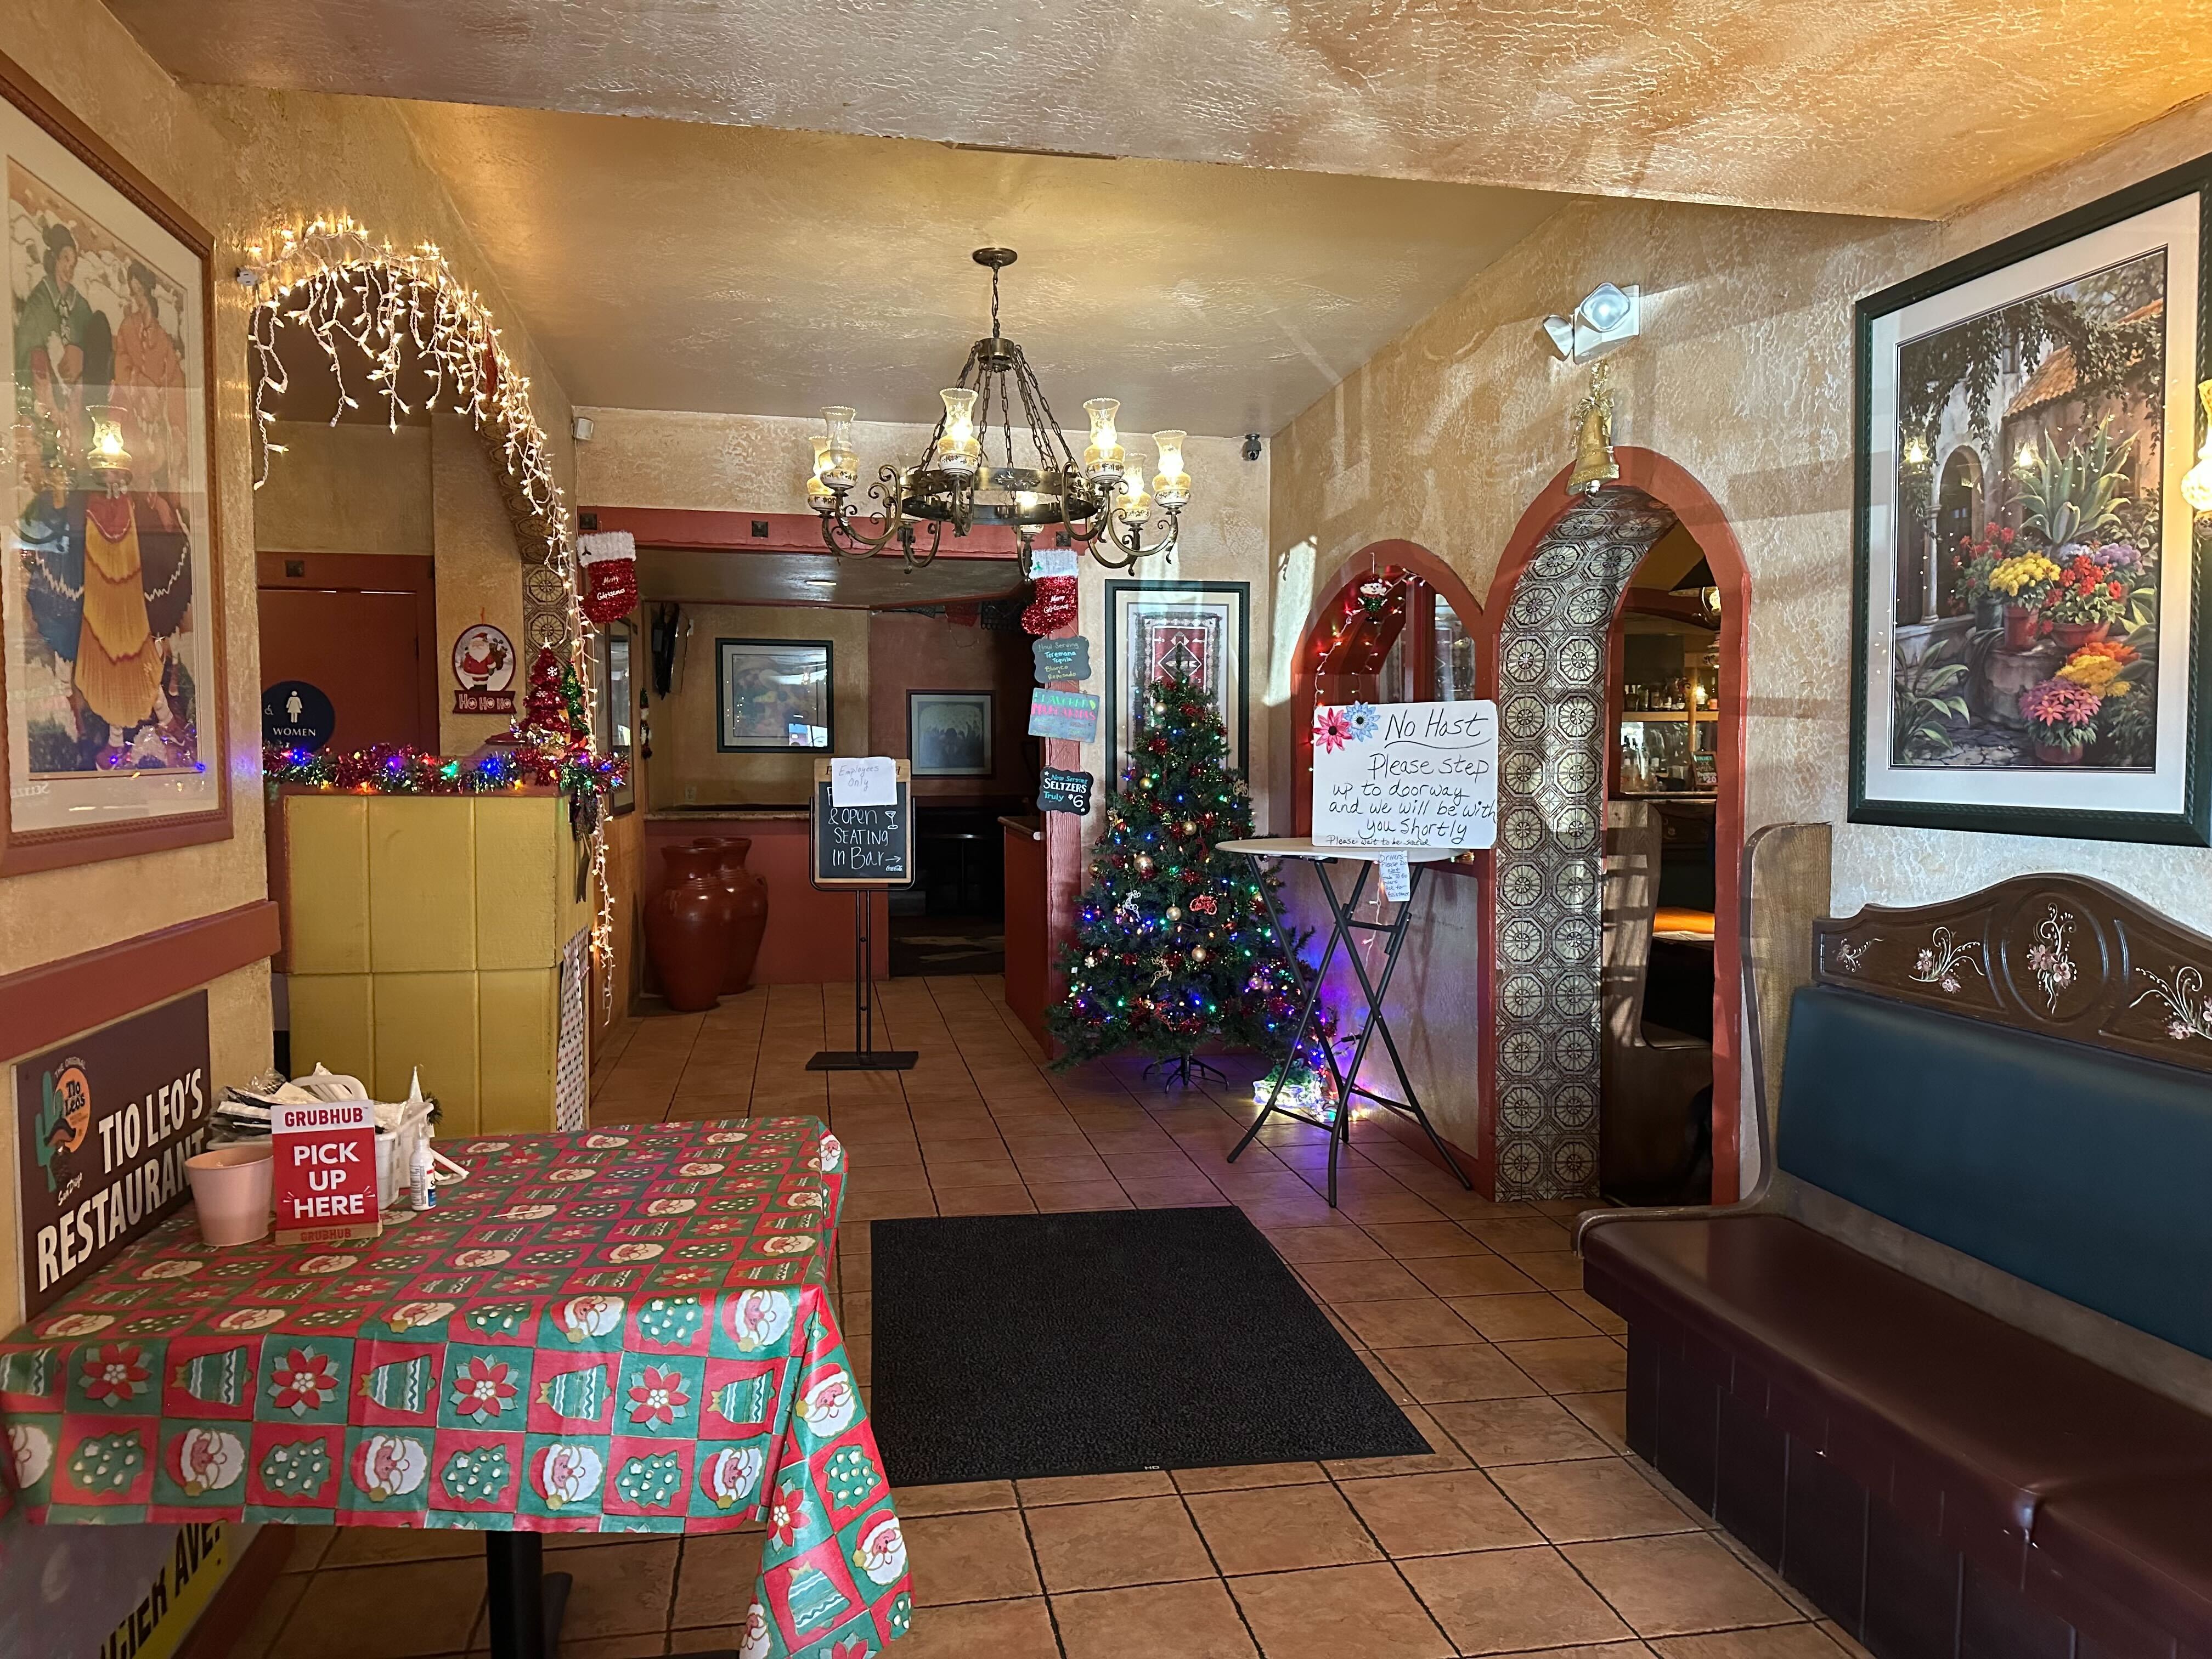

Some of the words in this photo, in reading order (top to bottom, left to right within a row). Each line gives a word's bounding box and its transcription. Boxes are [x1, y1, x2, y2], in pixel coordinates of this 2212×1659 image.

[597, 588, 625, 600] Christmas
[1048, 671, 1076, 680] Reposado
[273, 727, 316, 736] WOMEN
[1385, 709, 1416, 741] No
[838, 764, 879, 777] Employees
[1368, 753, 1434, 780] Please
[1065, 776, 1088, 784] Serving
[1043, 791, 1064, 802] Truly
[1333, 783, 1353, 800] up
[1361, 780, 1381, 795] to
[1389, 778, 1470, 806] doorway
[828, 808, 839, 825] &
[1329, 798, 1363, 814] and
[1399, 799, 1429, 815] will
[1437, 798, 1457, 816] be
[1463, 799, 1497, 823] with
[1358, 820, 1396, 839] you
[1325, 834, 1357, 845] Please
[851, 847, 884, 870] Bar
[54, 1062, 64, 1079] THE
[99, 1103, 140, 1174] TIO
[146, 1069, 203, 1148] LEO'S
[285, 1107, 363, 1127] GRUBHUB
[294, 1142, 360, 1166] PICK
[309, 1170, 347, 1191] UP
[37, 1127, 205, 1293] RESTAURANT
[294, 1194, 364, 1218] HERE
[301, 1228, 351, 1242] GRUBHUB
